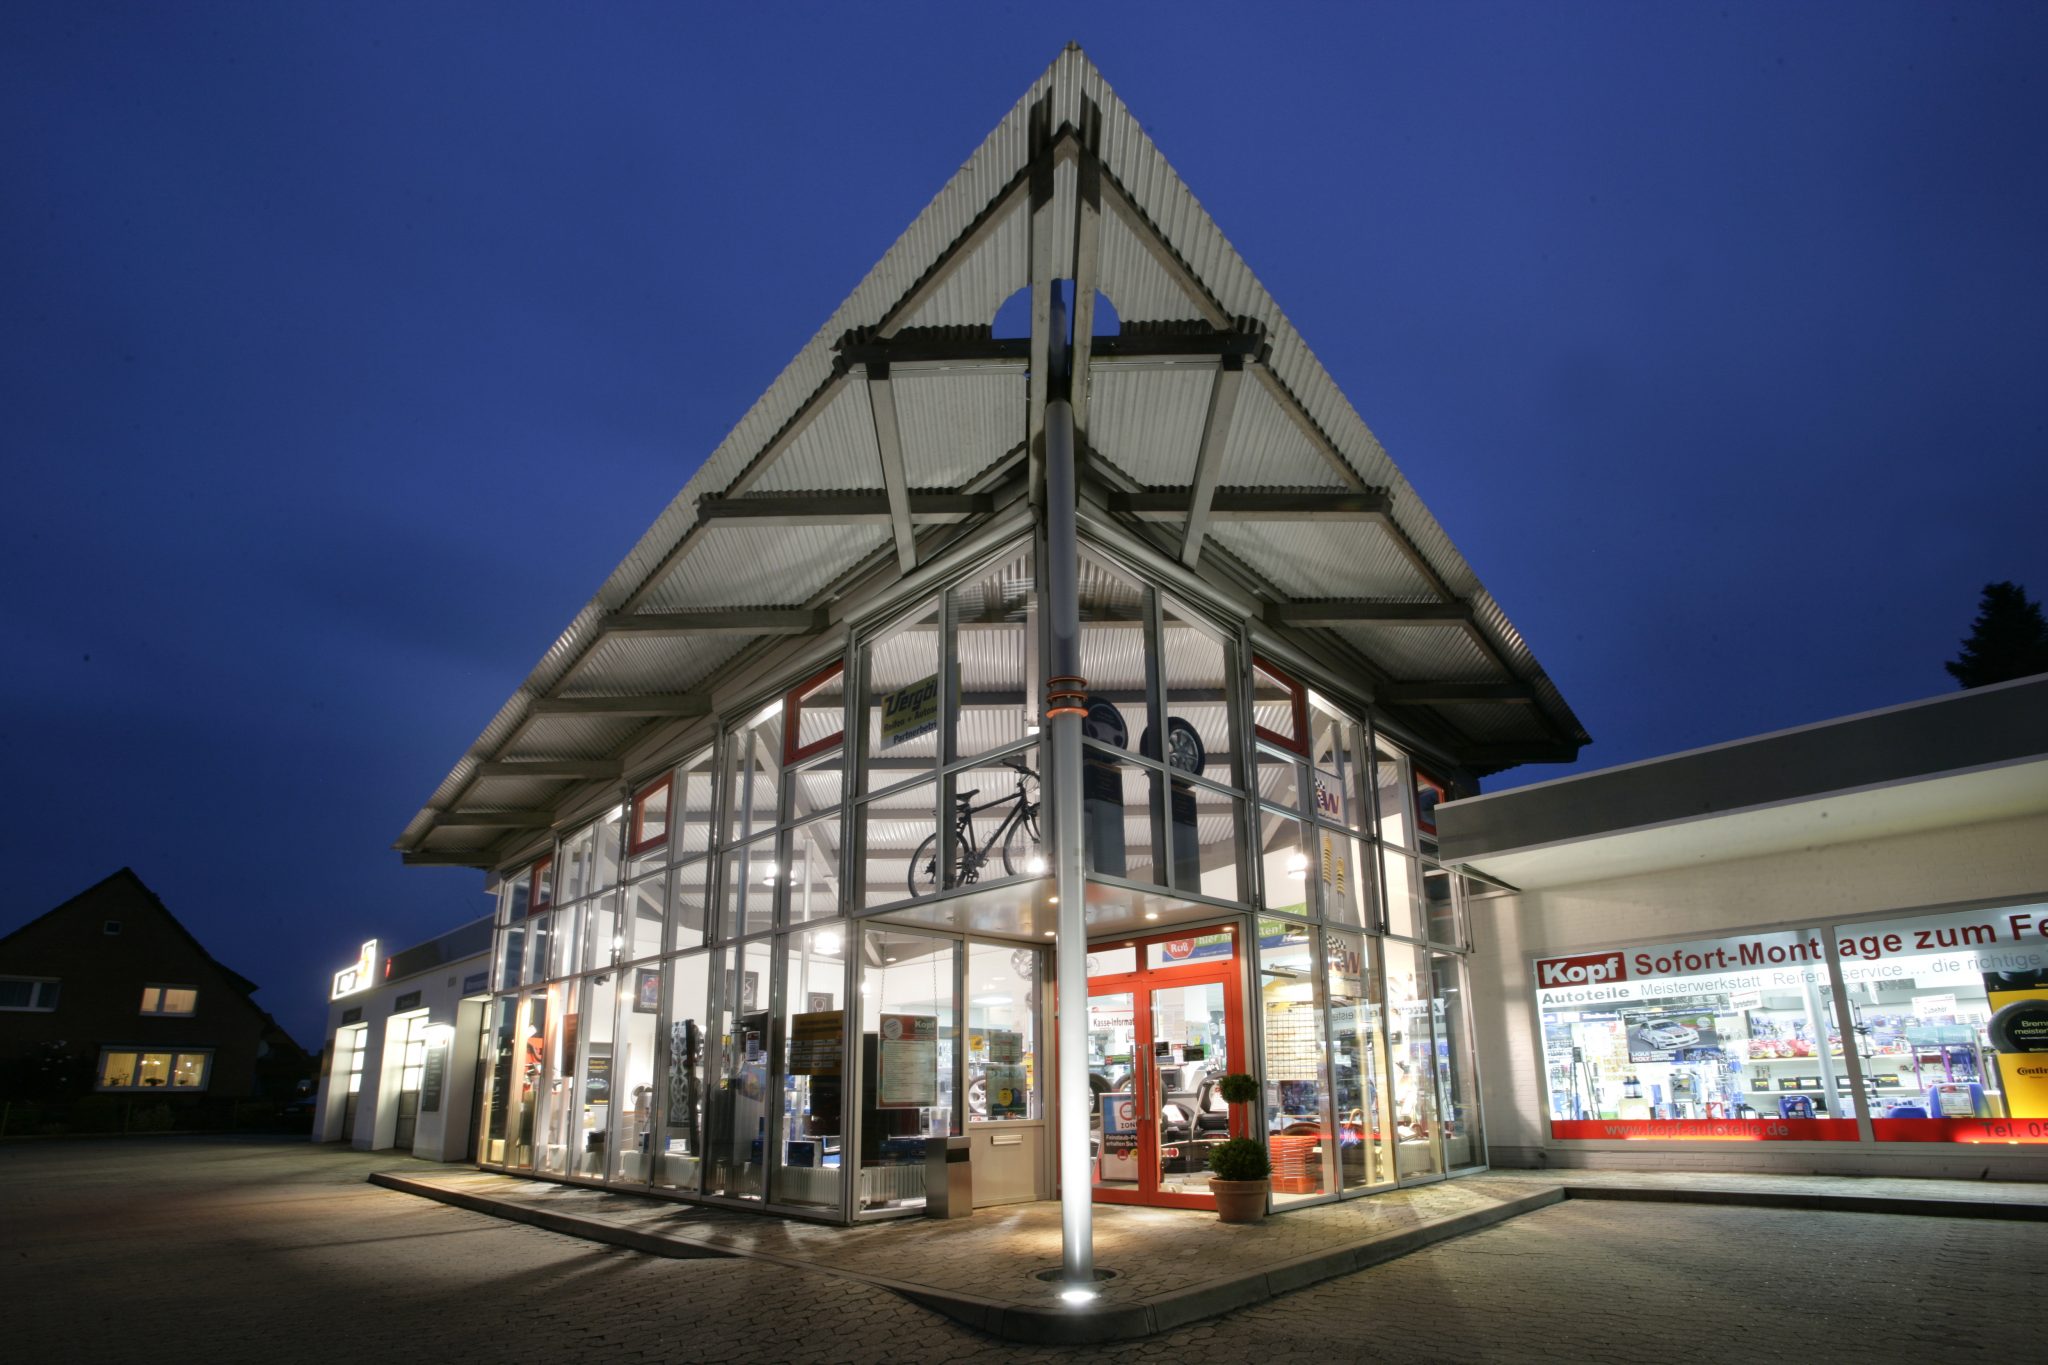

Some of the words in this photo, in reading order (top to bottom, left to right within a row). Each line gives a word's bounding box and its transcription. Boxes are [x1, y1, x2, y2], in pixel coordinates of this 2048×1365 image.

[884, 679, 938, 717] Vergöl
[893, 720, 937, 744] Partnerbetri
[1542, 957, 1620, 985] Kopf
[1914, 922, 1997, 950] zum
[1542, 987, 1630, 1005] Autoteile
[1640, 975, 1761, 996] Meisterwerkstatt
[1932, 959, 1960, 973] die
[1967, 951, 2041, 971] richtige
[1093, 1017, 1134, 1028] Kasse-Informat
[1605, 1122, 1789, 1139] www.kopf-autoteile.de
[1979, 1122, 2021, 1137] Tel.
